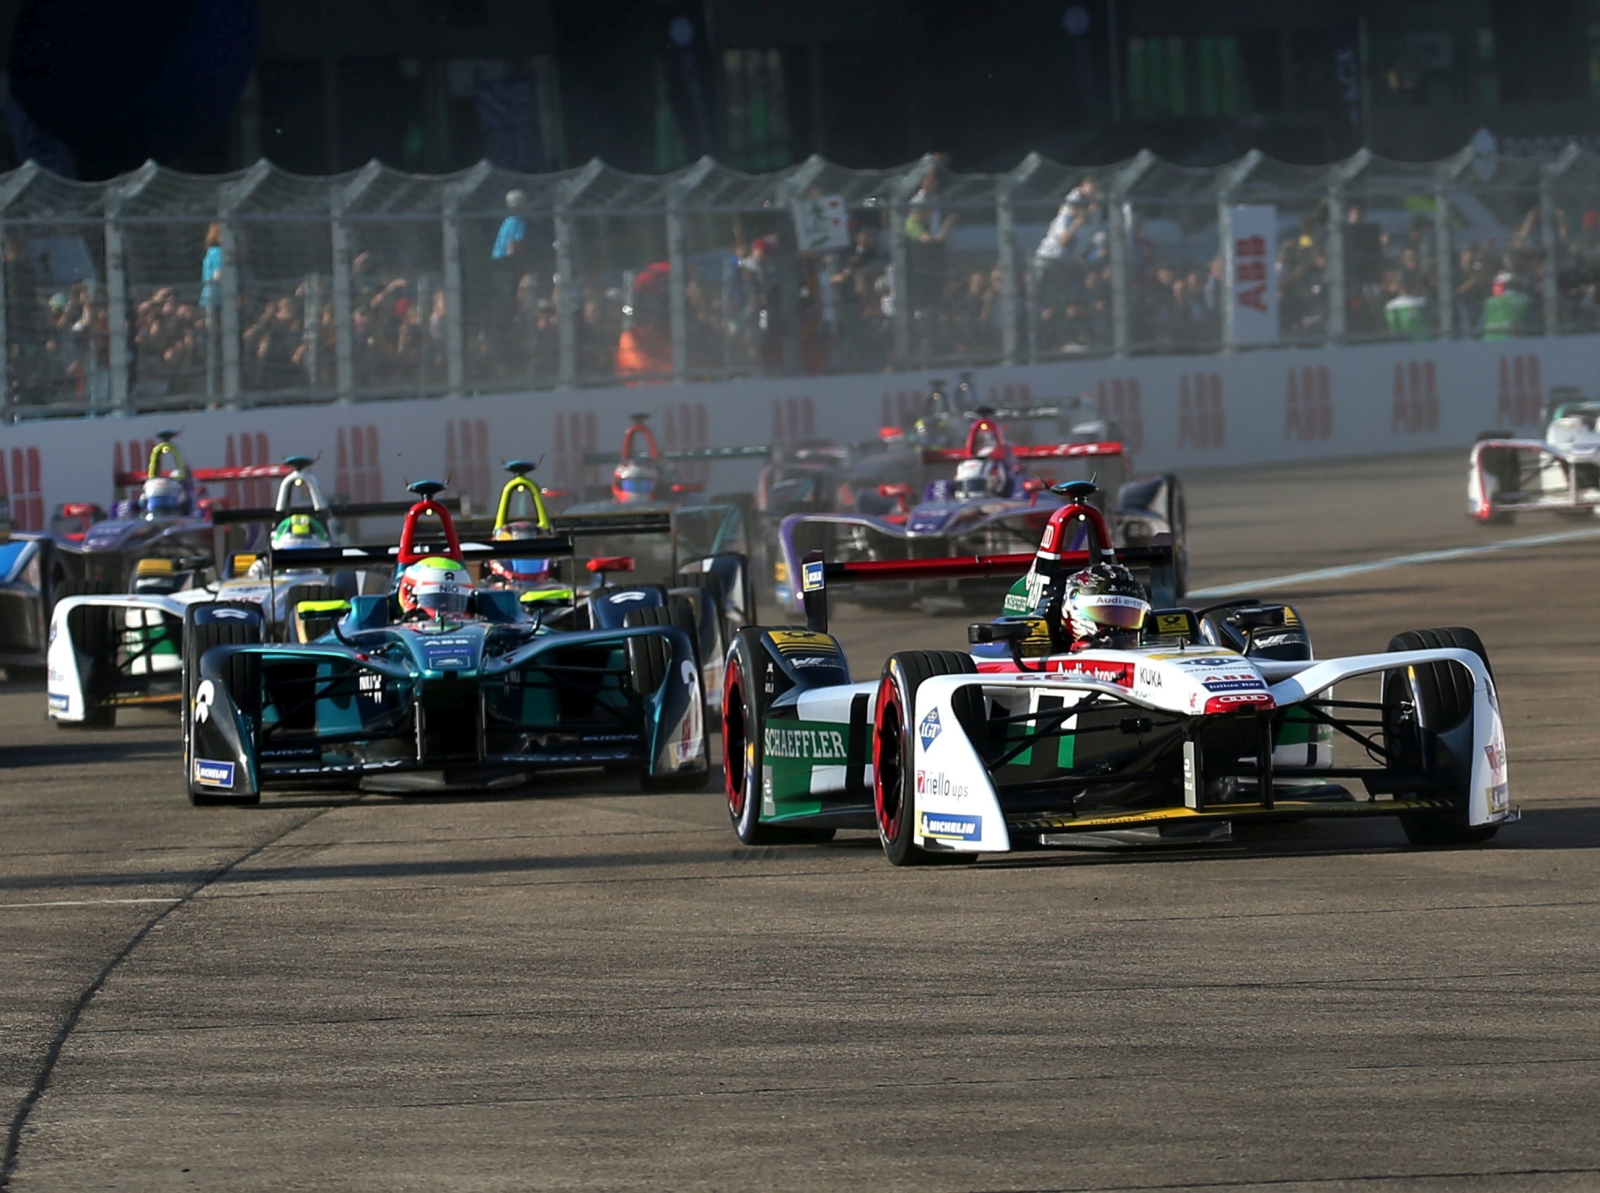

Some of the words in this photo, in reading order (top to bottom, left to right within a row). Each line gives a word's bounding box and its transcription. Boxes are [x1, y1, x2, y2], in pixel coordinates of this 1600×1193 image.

[1236, 234, 1268, 313] ABB
[1179, 372, 1226, 450] ABB
[1285, 365, 1332, 441] ABB
[1392, 360, 1438, 434] ABB
[1140, 667, 1163, 688] KUKA
[1204, 674, 1256, 682] ABB
[764, 727, 848, 758] SCHAEFFLER
[921, 722, 940, 739] LGT
[926, 771, 950, 797] riello
[952, 785, 969, 801] ups
[928, 820, 976, 834] MICHELIN
